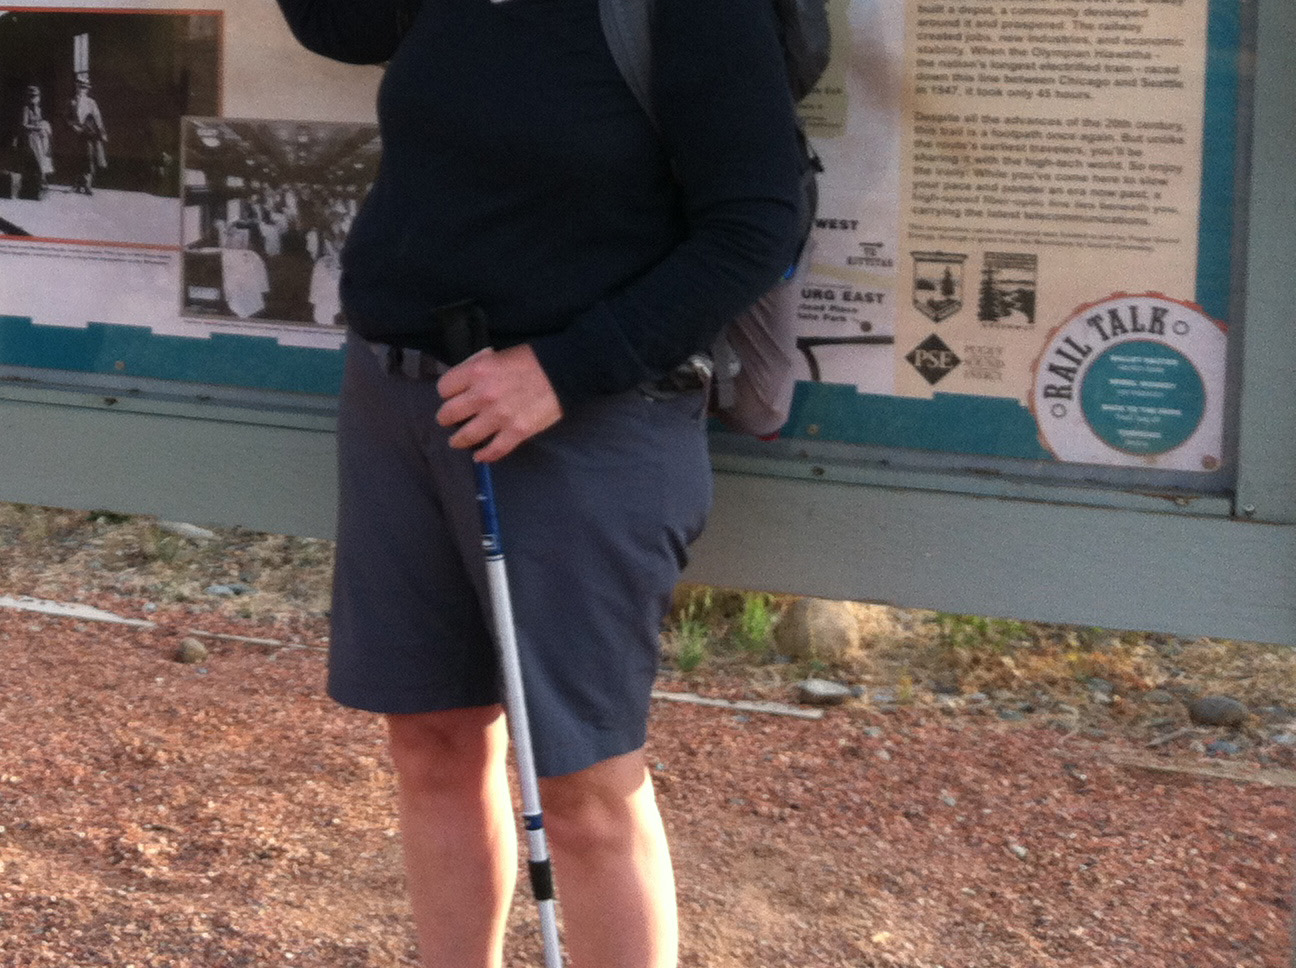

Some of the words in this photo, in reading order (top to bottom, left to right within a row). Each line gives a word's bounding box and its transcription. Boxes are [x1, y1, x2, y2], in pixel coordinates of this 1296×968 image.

[815, 219, 858, 230] WEST
[842, 291, 885, 304] EAST
[915, 349, 954, 368] PSE
[1043, 336, 1092, 401] RAIL
[1086, 305, 1169, 341] TALK
